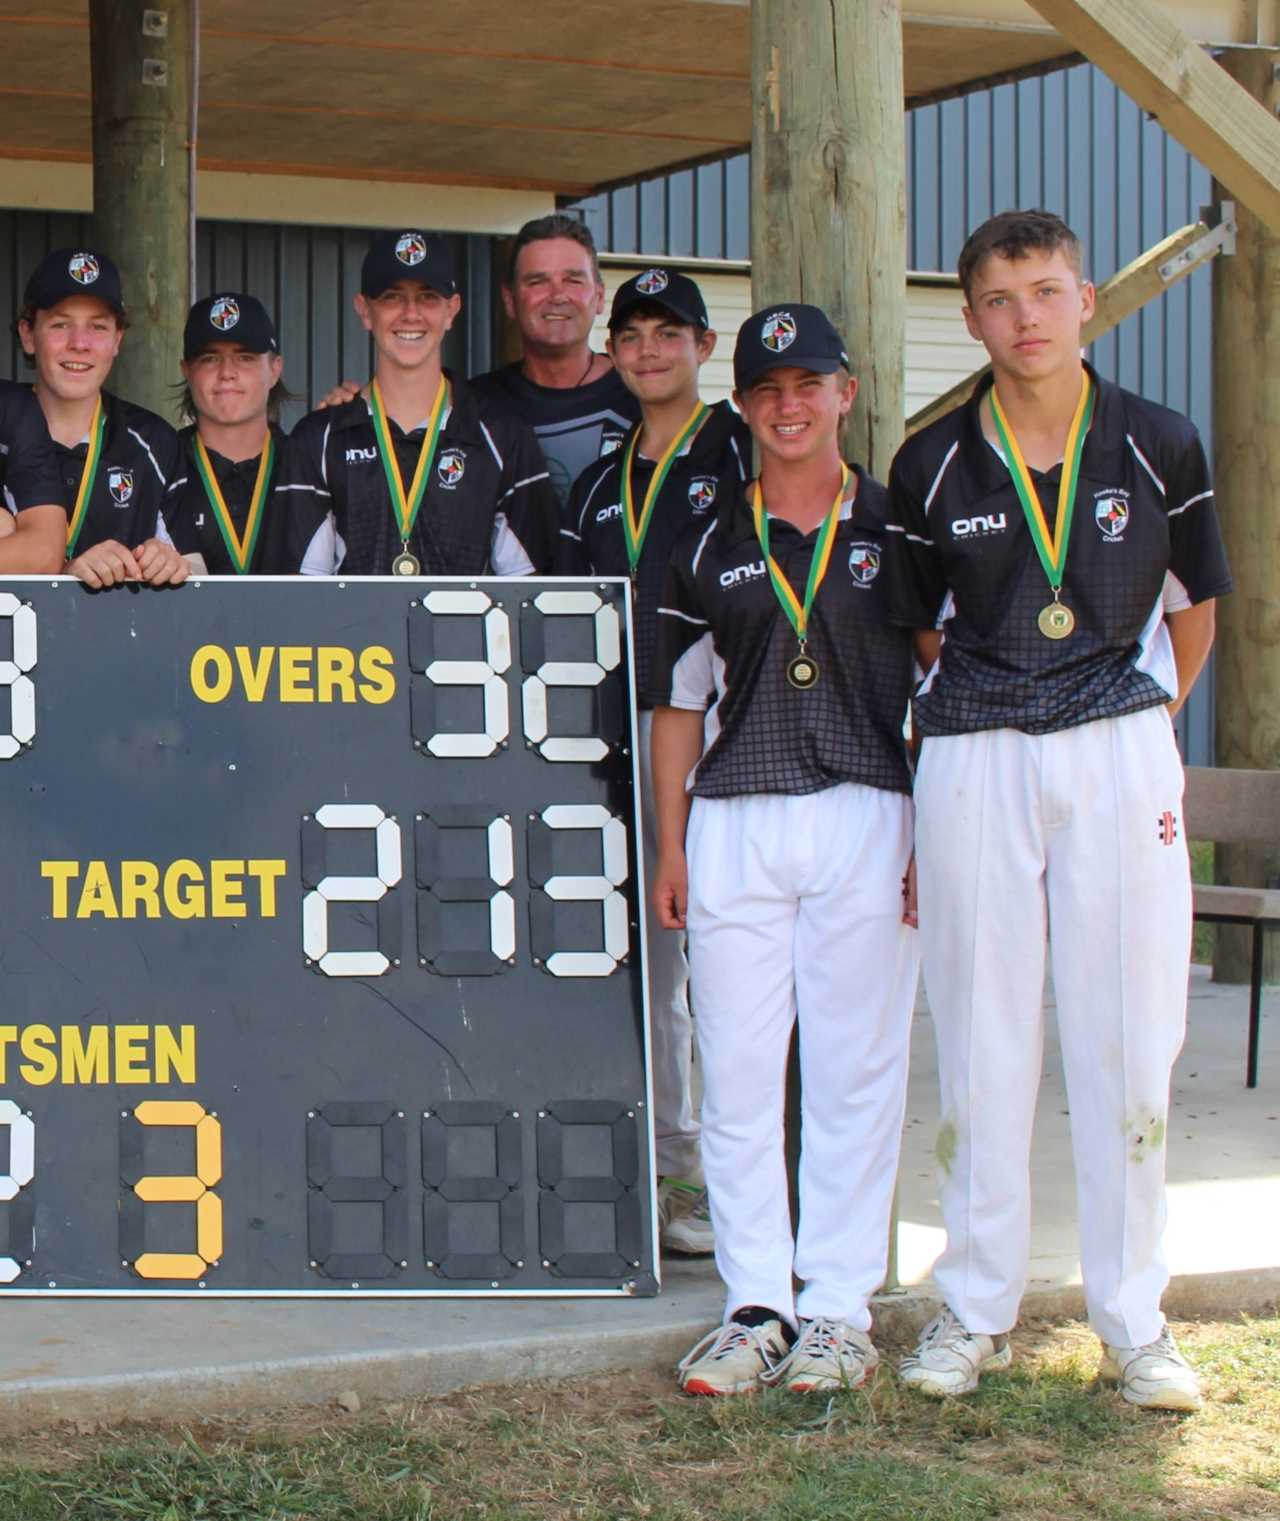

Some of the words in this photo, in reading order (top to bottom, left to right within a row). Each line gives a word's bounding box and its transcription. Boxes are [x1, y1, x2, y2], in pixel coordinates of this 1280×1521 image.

[951, 512, 1007, 535] onu
[720, 560, 767, 587] onu
[189, 644, 397, 705] OVERS
[40, 859, 287, 920] TARGET
[133, 1100, 223, 1280] 3
